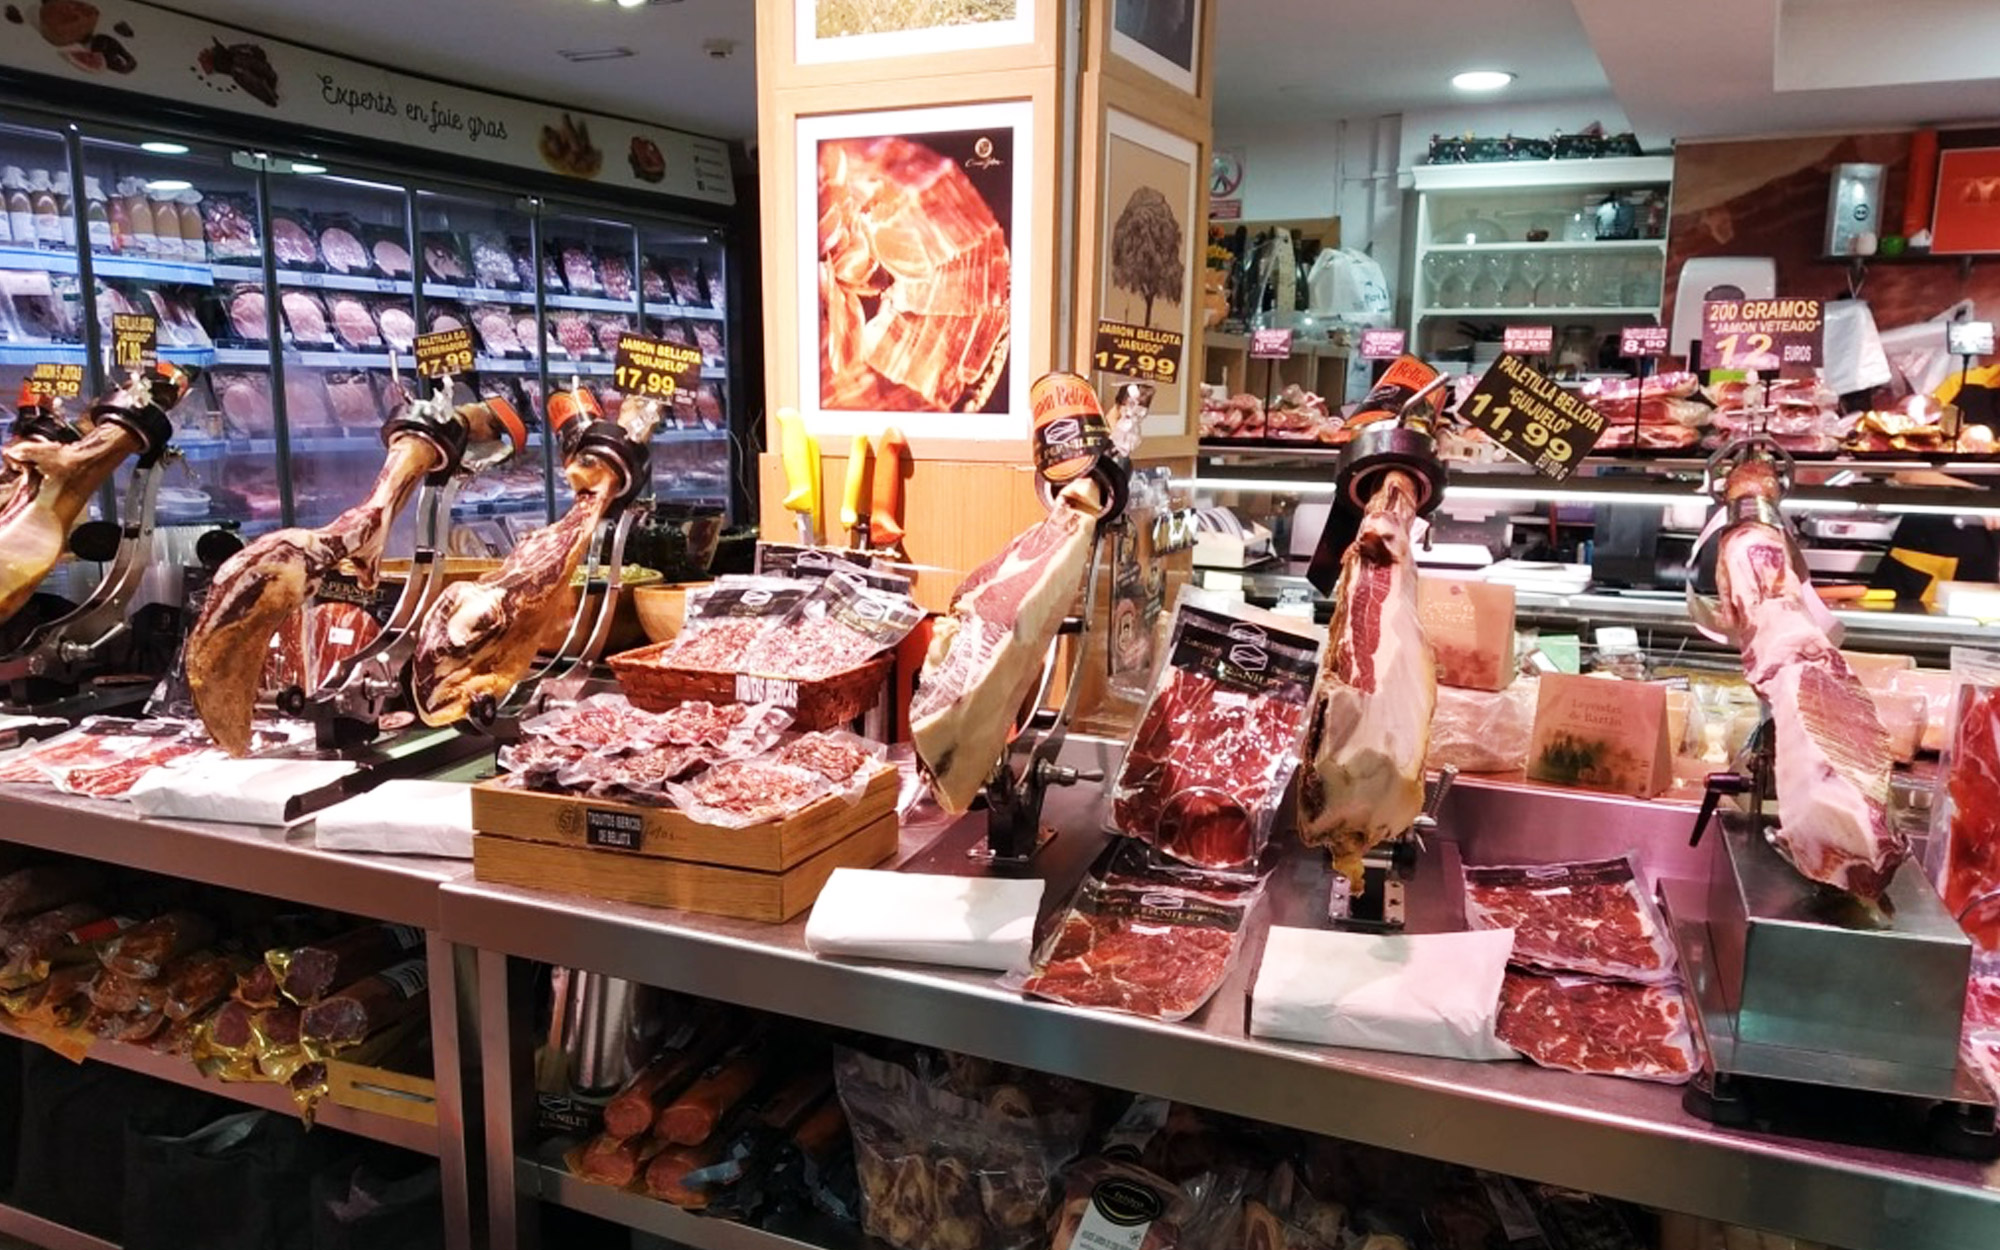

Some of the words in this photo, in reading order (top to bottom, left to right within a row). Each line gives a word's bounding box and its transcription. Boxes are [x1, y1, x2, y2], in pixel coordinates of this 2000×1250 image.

[316, 72, 398, 115] Experts
[406, 102, 429, 123] en
[430, 101, 463, 133] foie
[467, 115, 508, 141] gras
[1709, 303, 1738, 321] 200
[1742, 300, 1819, 319] GRAMOS
[1099, 323, 1135, 338] JAMON
[1137, 329, 1181, 345] BELLOTA
[620, 338, 655, 354] JAMON
[657, 344, 701, 364] BELLOTA
[1715, 333, 1779, 369] 12
[1784, 345, 1811, 361] EUROS
[616, 366, 675, 396] 17,99
[1498, 355, 1557, 403] PALETILLA
[1554, 391, 1605, 434] BELLOTA
[1471, 393, 1573, 462] 11,99
